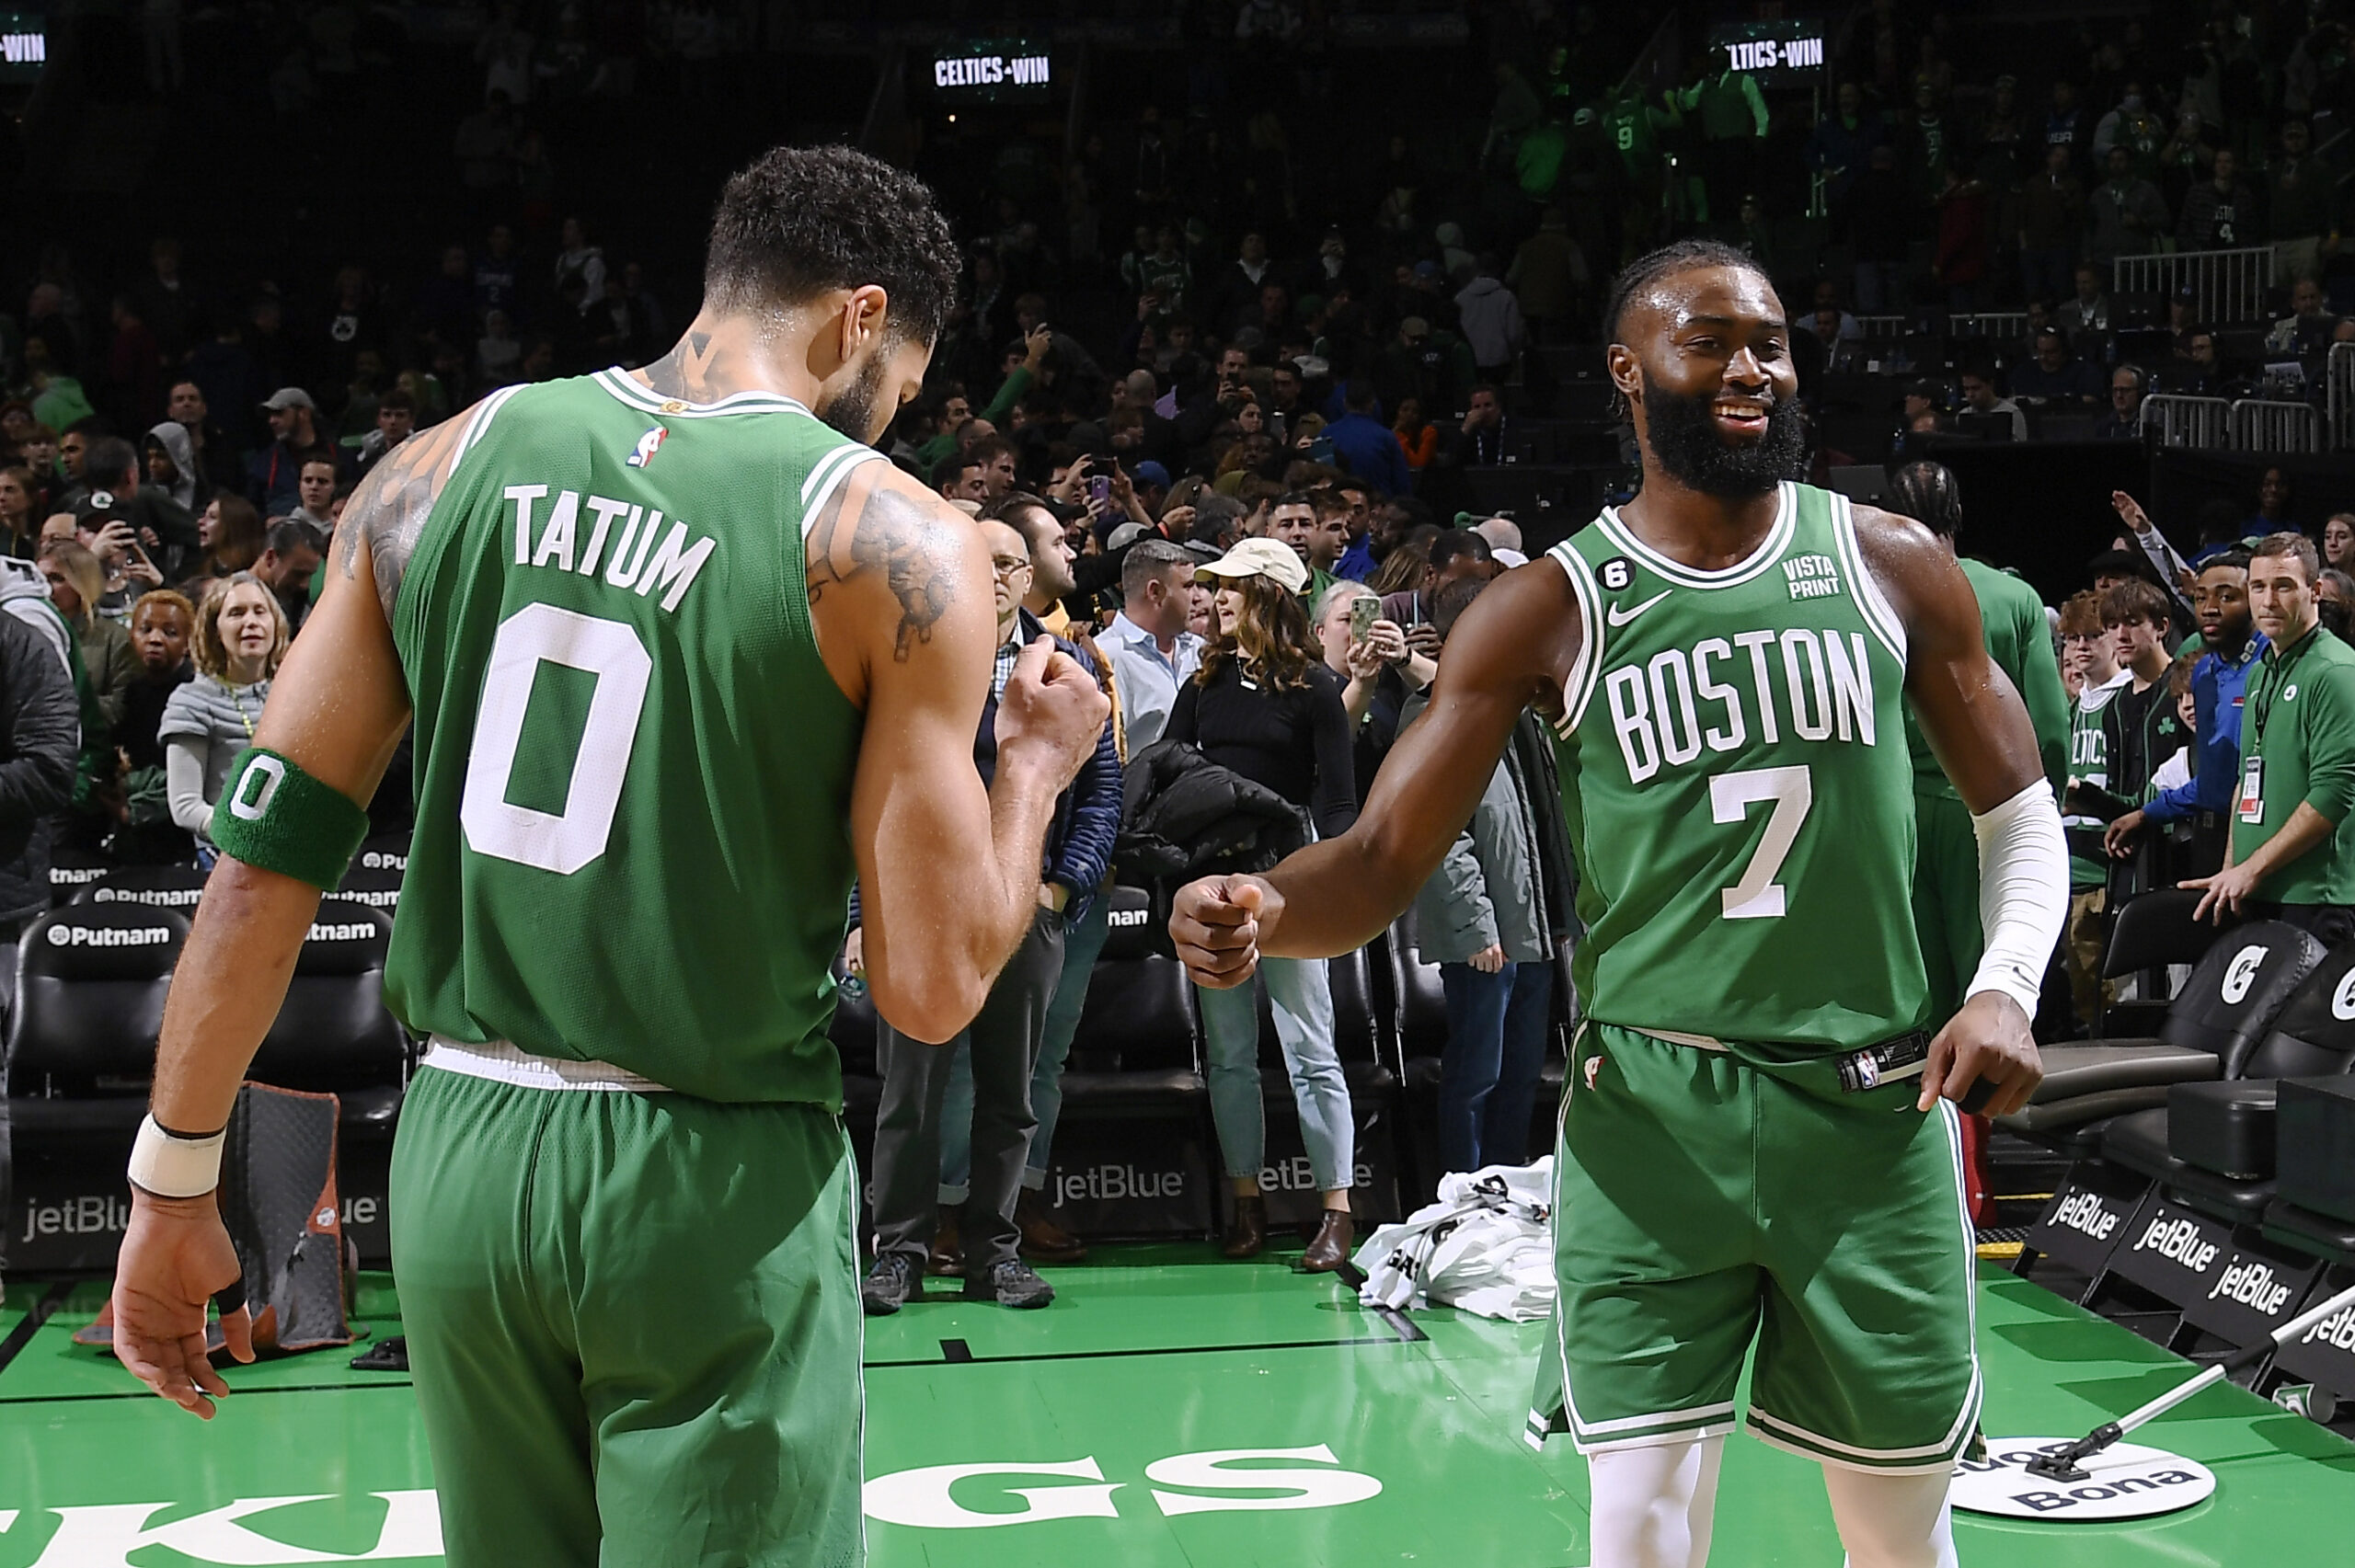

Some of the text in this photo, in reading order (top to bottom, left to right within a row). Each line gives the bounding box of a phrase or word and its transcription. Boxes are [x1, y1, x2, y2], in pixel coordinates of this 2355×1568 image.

[2, 33, 46, 63] WIN
[1725, 38, 1823, 71] LTICS WIN
[935, 55, 1050, 86] CELTICS WIN
[1618, 127, 1634, 151] 9
[504, 484, 716, 613] TATUM
[1782, 555, 1838, 581] VISTA
[1604, 560, 1628, 589] 6
[1788, 577, 1840, 600] PRINT
[1605, 628, 1876, 784] BOSTON
[460, 602, 653, 876] 0
[230, 754, 285, 820] 0
[1708, 764, 1812, 919] 7
[71, 926, 169, 946] Putnam
[305, 922, 375, 941] tnam
[1053, 1163, 1184, 1208] jetBlue
[2047, 1185, 2118, 1241] jetBlue
[2132, 1208, 2218, 1273] jetBlue
[2208, 1253, 2291, 1316] jetBlue
[2008, 1470, 2202, 1512] Bona
